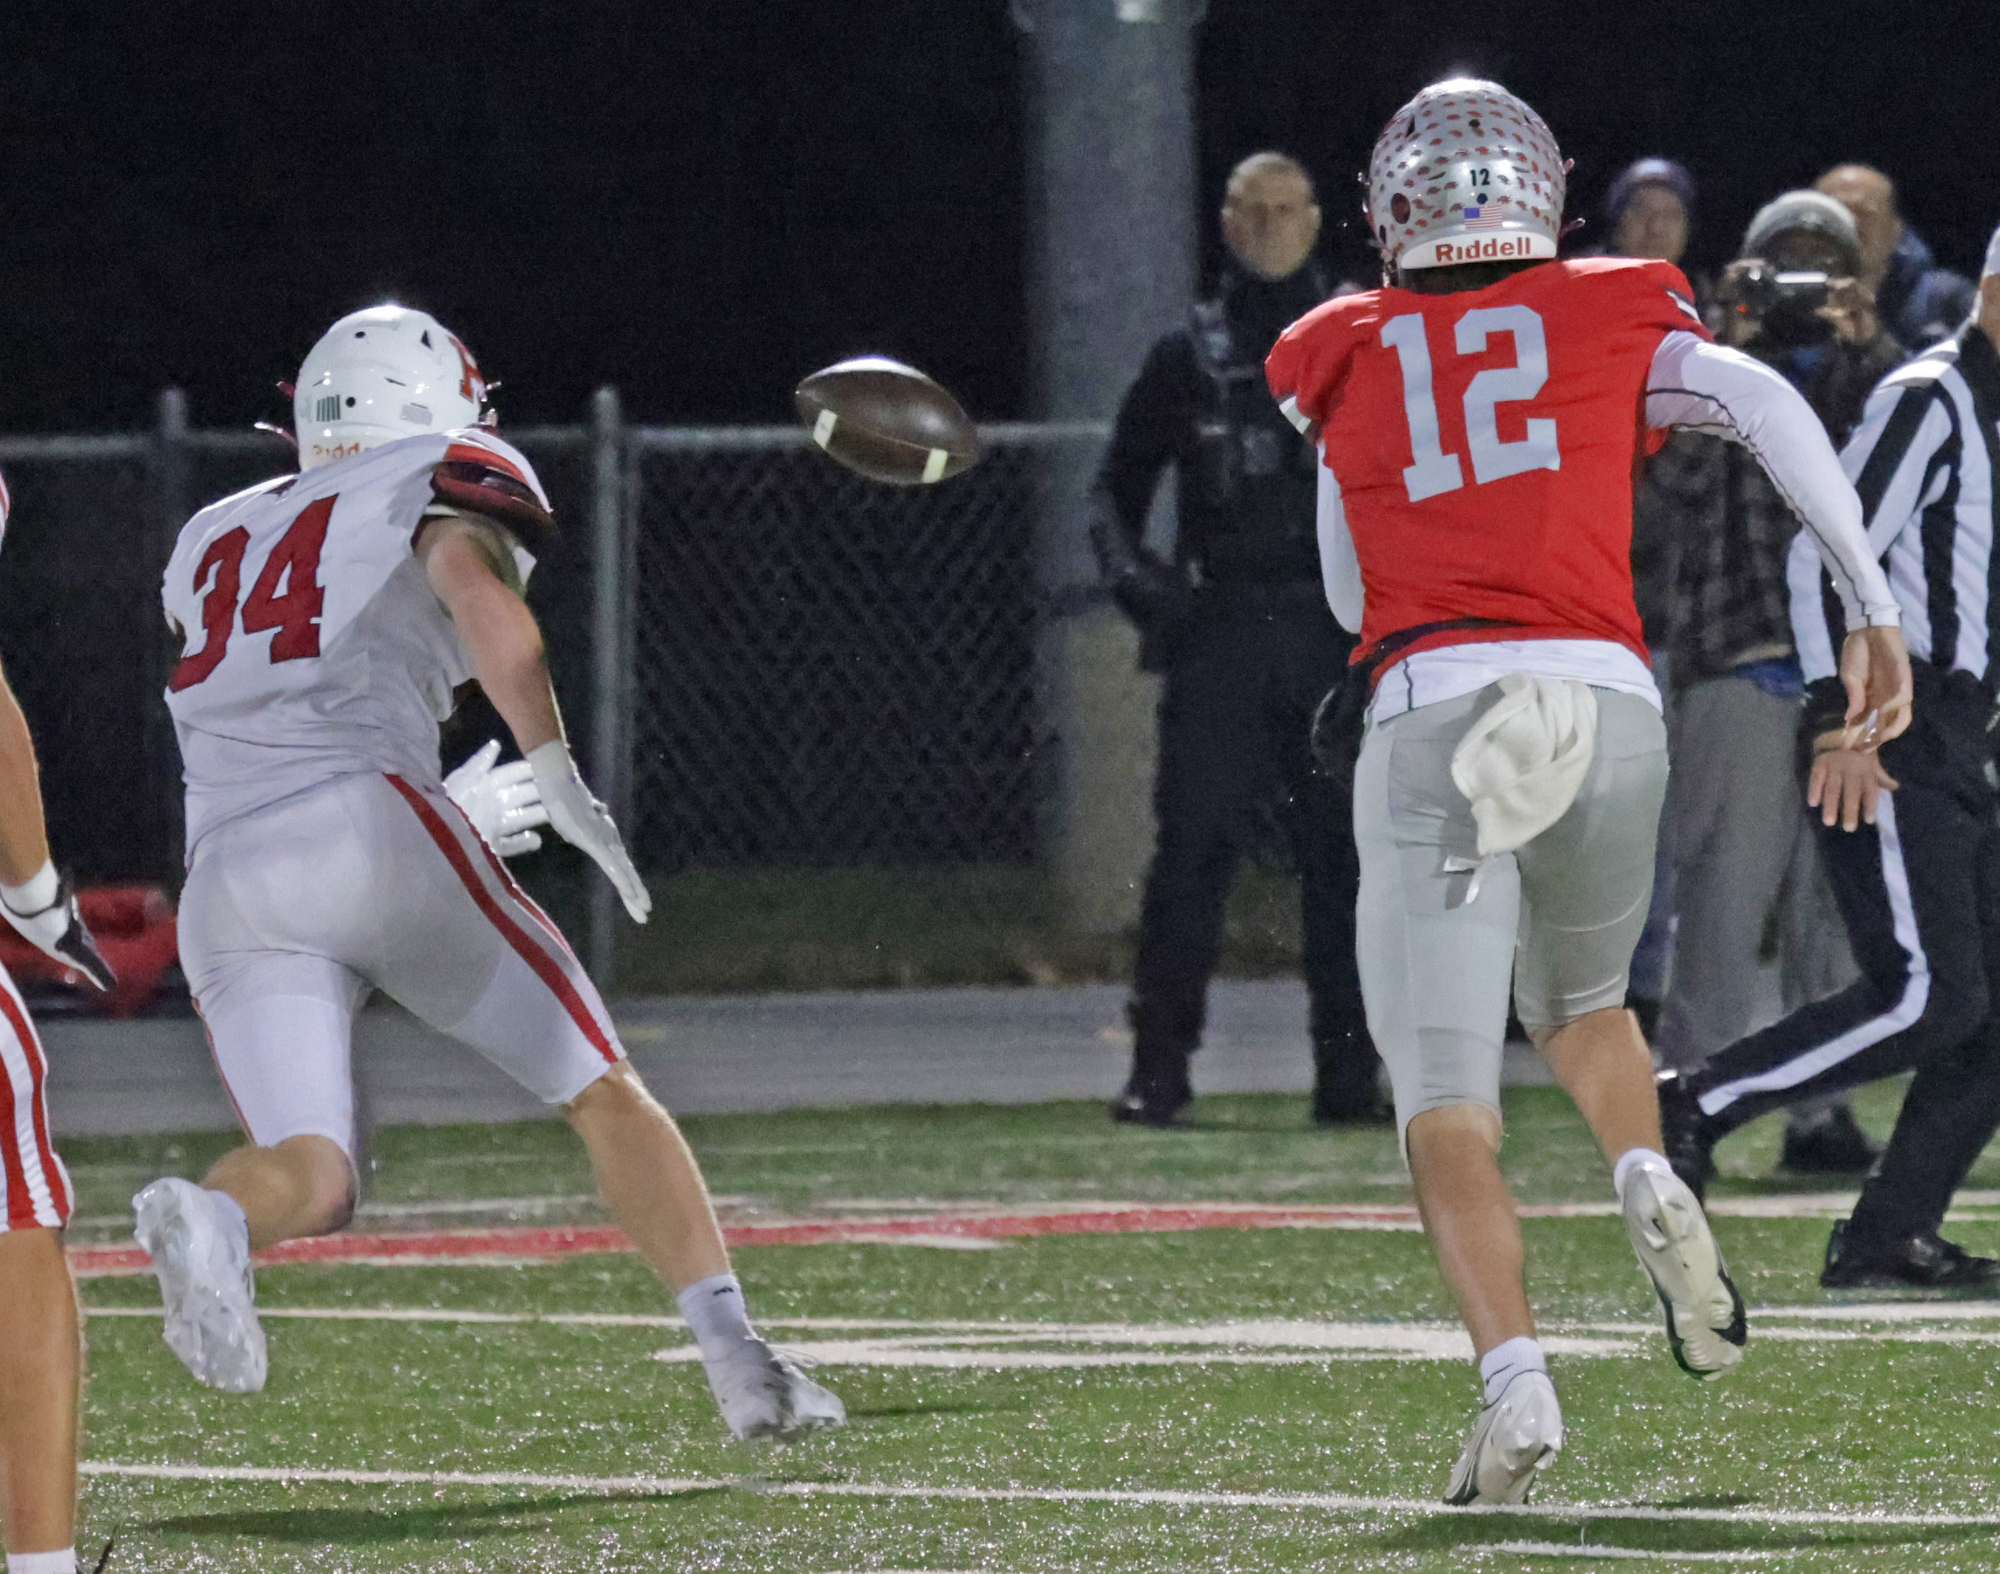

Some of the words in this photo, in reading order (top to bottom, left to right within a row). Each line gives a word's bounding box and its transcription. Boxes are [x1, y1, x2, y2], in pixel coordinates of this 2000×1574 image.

[1470, 168, 1491, 186] 12
[1436, 237, 1531, 262] Riddell
[1380, 304, 1561, 503] 12
[167, 492, 340, 694] 34
